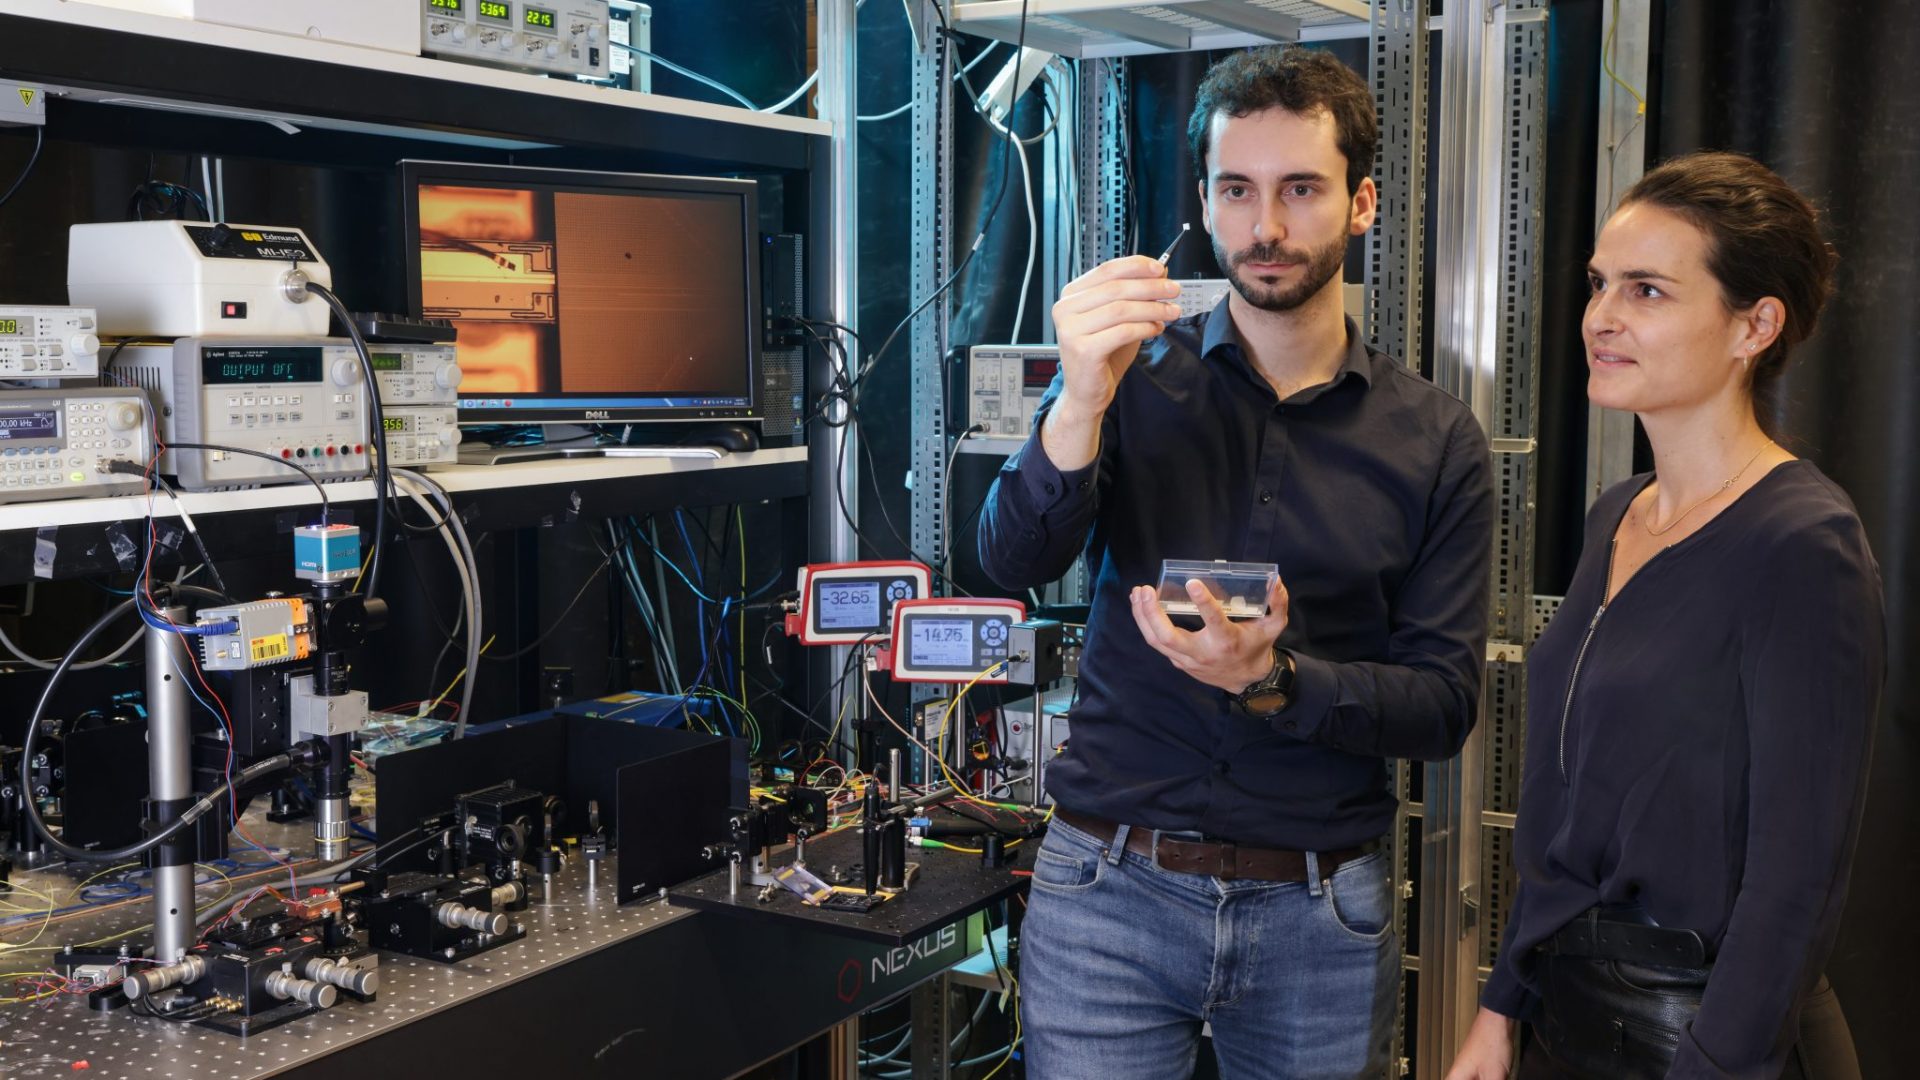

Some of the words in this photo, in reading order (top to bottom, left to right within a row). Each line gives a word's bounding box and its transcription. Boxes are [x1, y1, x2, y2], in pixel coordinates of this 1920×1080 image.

[480, 2, 506, 17] 5369
[527, 11, 551, 26] 2215
[262, 233, 300, 242] Edmund
[223, 364, 264, 376] OUTPUT
[273, 363, 293, 375] OFF
[585, 411, 610, 419] DELL
[20, 419, 32, 427] kHz
[822, 591, 870, 605] -32.65
[871, 923, 956, 983] NEXUS
